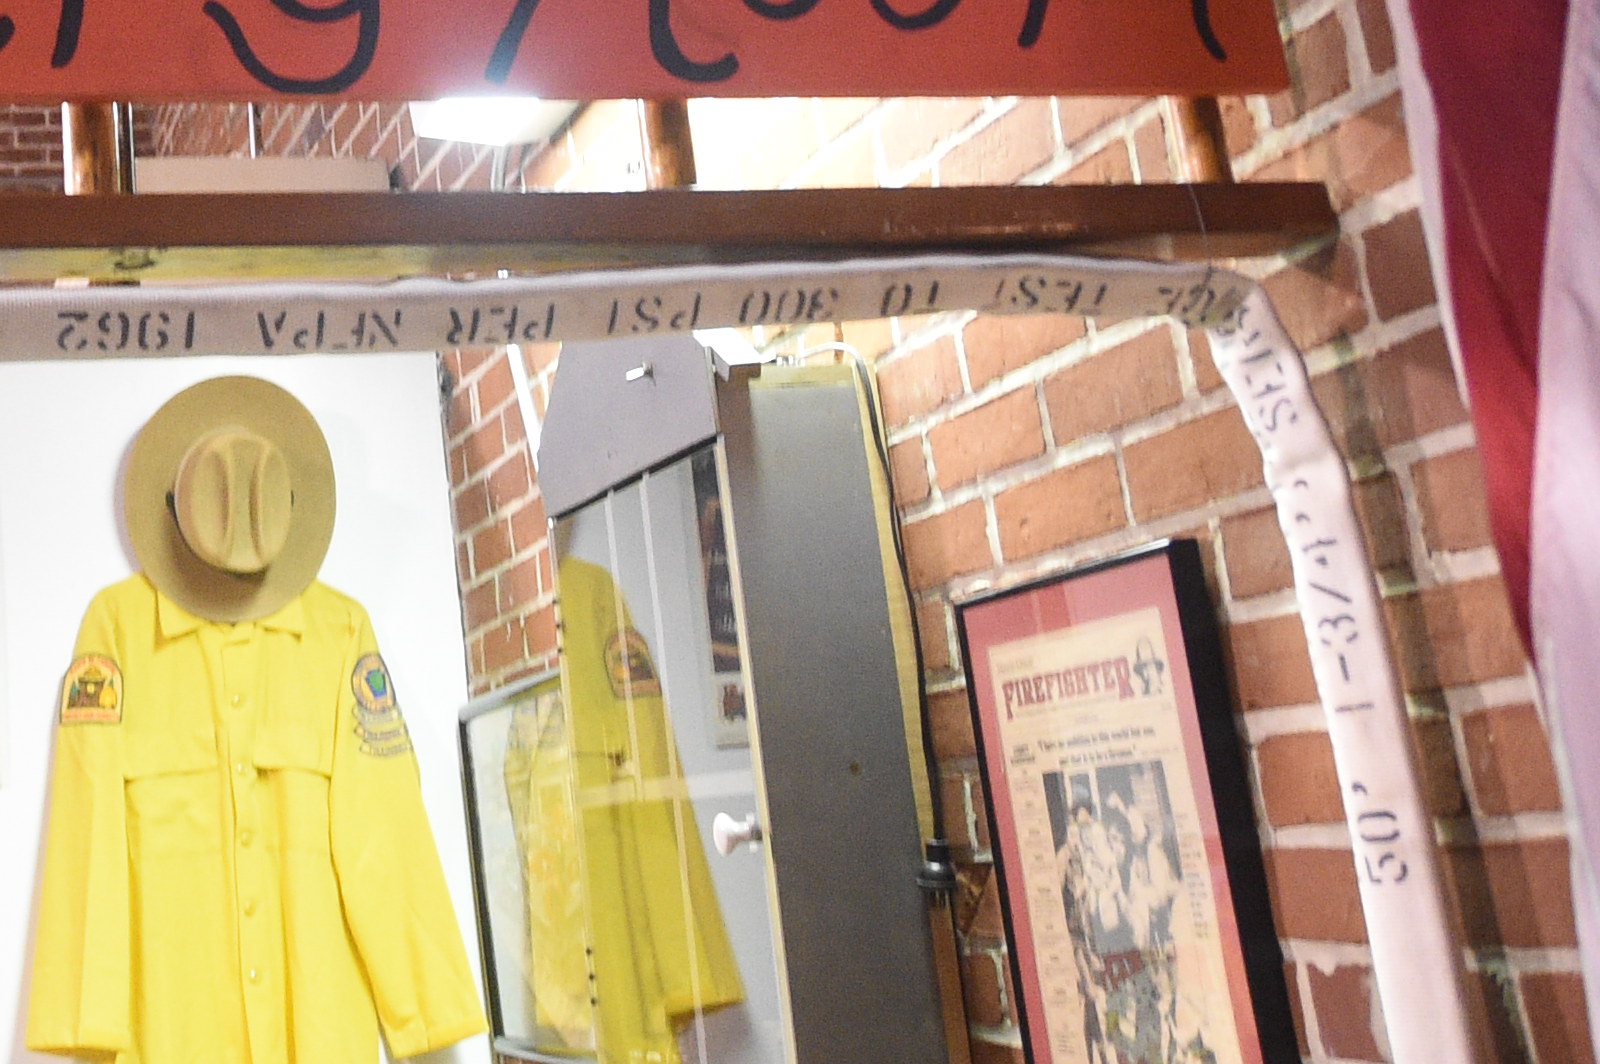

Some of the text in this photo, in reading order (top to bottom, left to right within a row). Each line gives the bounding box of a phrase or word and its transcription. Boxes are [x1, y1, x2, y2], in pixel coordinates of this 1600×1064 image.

[738, 288, 840, 324] 300
[997, 276, 1106, 305] TEST
[56, 310, 196, 351] 1962
[256, 310, 403, 350] NFPA
[448, 303, 555, 345] PER
[608, 293, 701, 334] PSI
[1001, 656, 1135, 721] FIREFIGHTER
